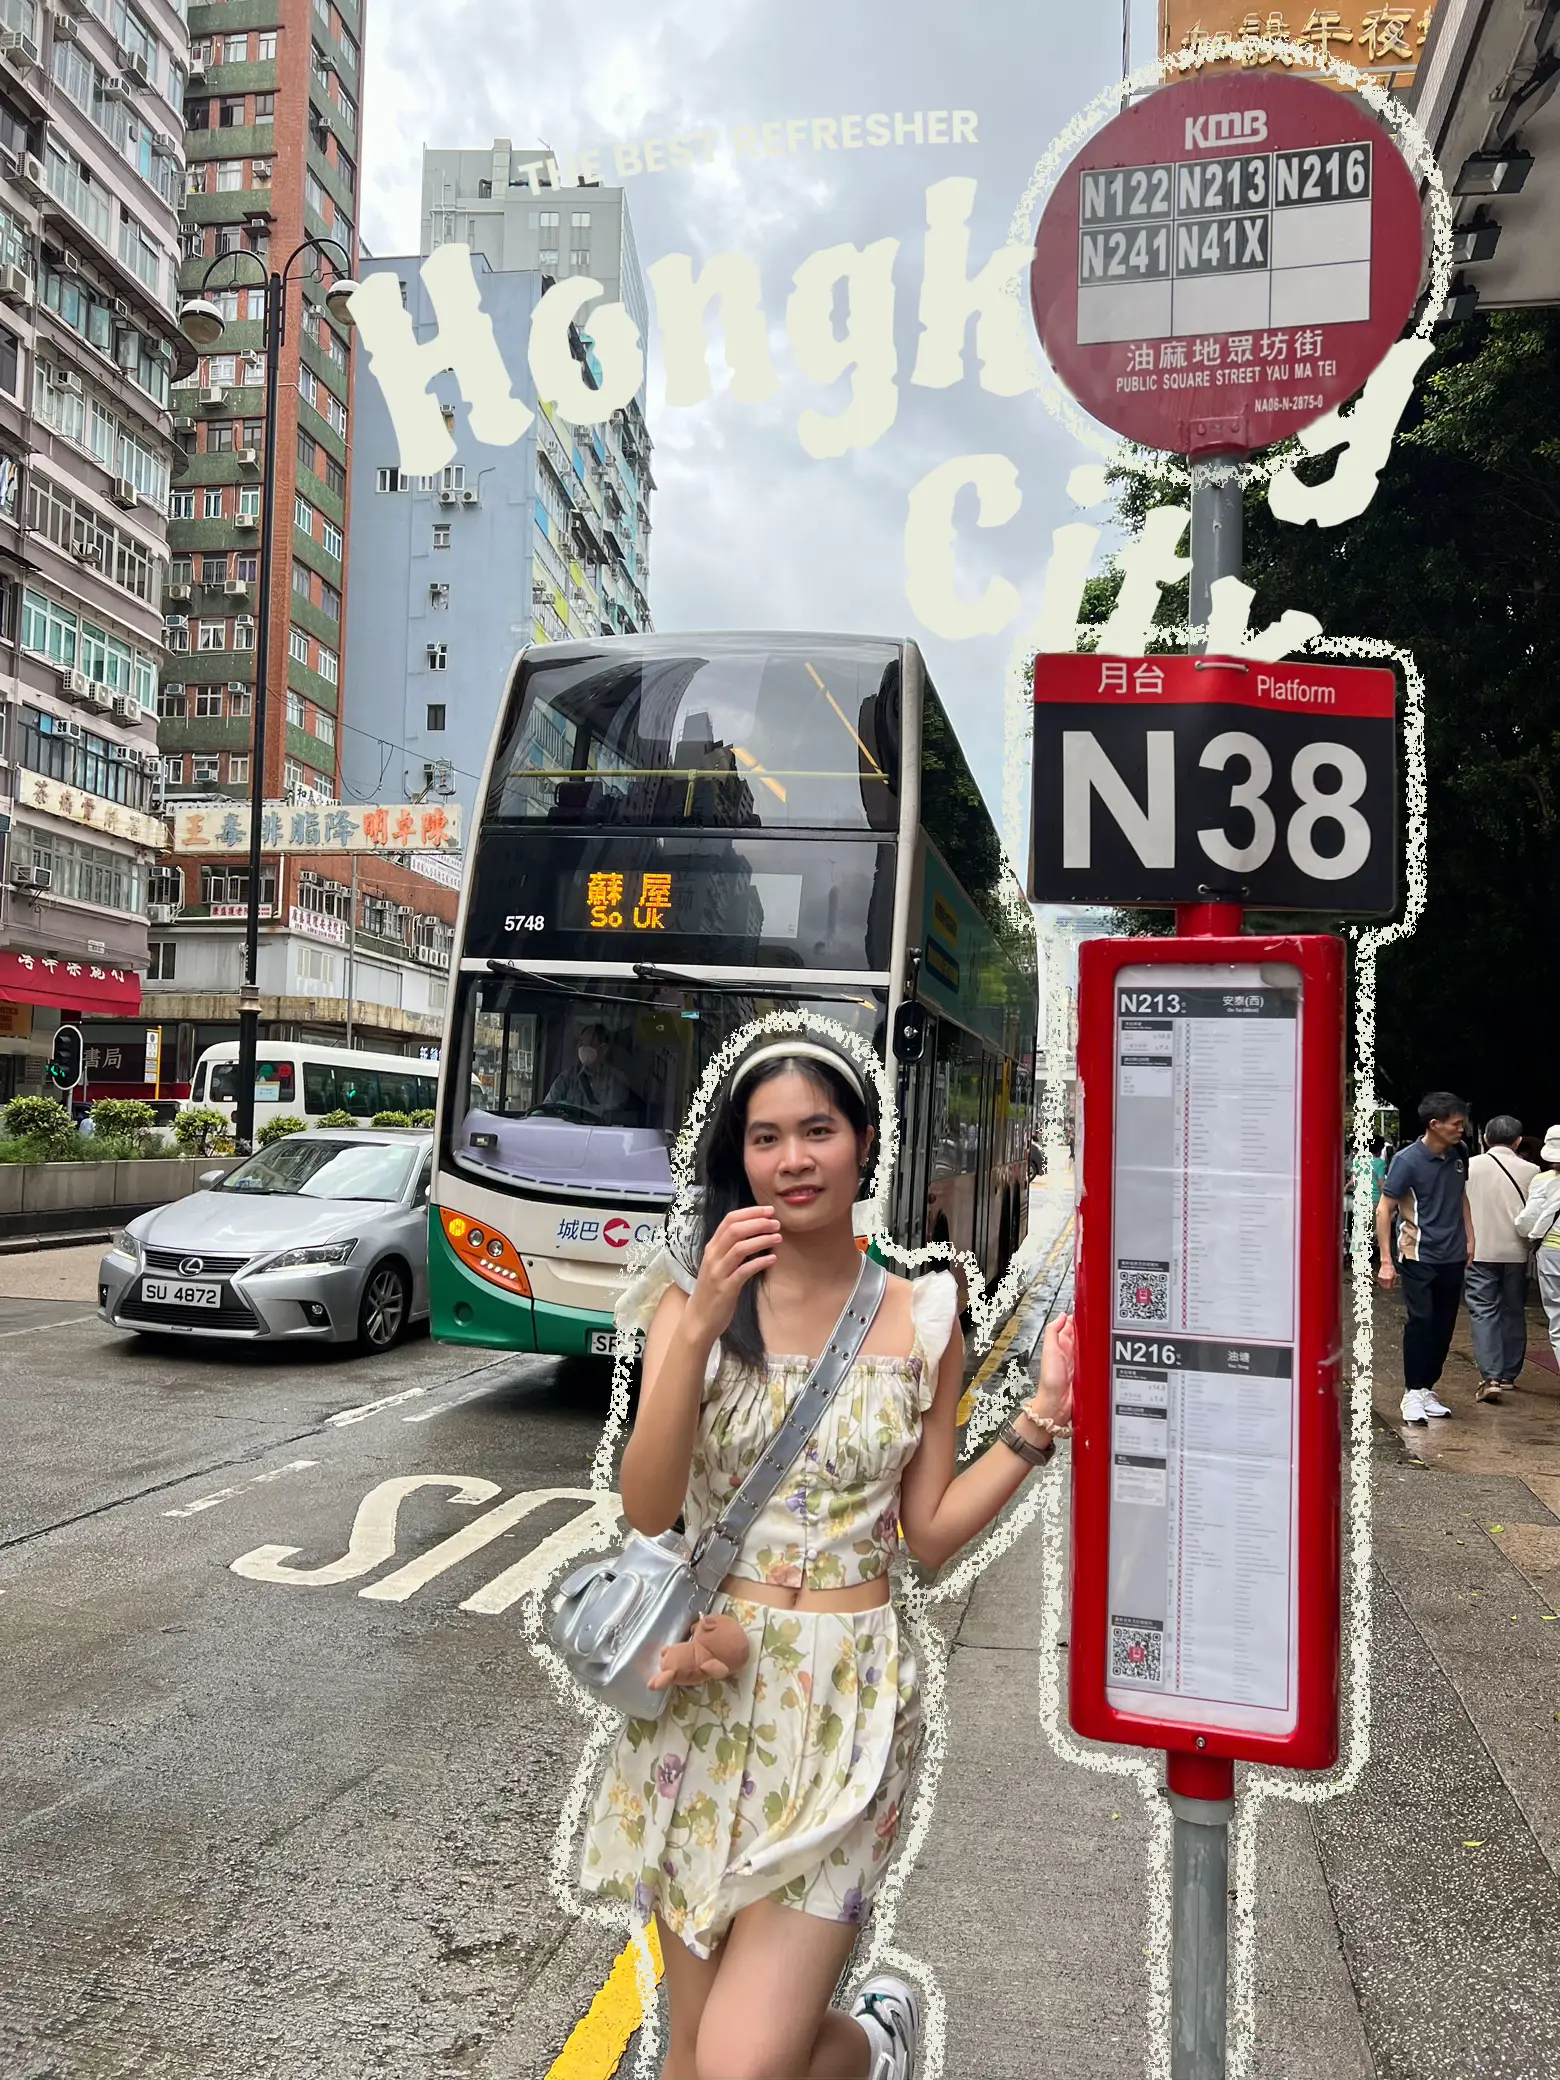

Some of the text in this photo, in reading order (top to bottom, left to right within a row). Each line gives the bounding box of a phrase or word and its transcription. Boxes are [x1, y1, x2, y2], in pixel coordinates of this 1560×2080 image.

[1083, 149, 1366, 220] N122 N213 N216
[1081, 217, 1265, 279] N241 N41X
[1126, 329, 1324, 373] 油麻地眾坊街
[1116, 359, 1337, 393] PUBLIC SQUARE STREET YAU MA TEI
[1254, 394, 1324, 413] NA06-N-2875-0
[1098, 662, 1165, 695] 月台
[1256, 675, 1336, 704] Platform
[1062, 730, 1373, 881] N38
[504, 914, 545, 932] 5748
[590, 906, 666, 930] So Uk
[1121, 993, 1181, 1014] N213
[1222, 995, 1265, 1008] 安泰(西)
[82, 1047, 122, 1070] 書局
[556, 1218, 601, 1241] 城巴
[146, 1284, 217, 1305] SU 4872
[1114, 1339, 1176, 1366] N216
